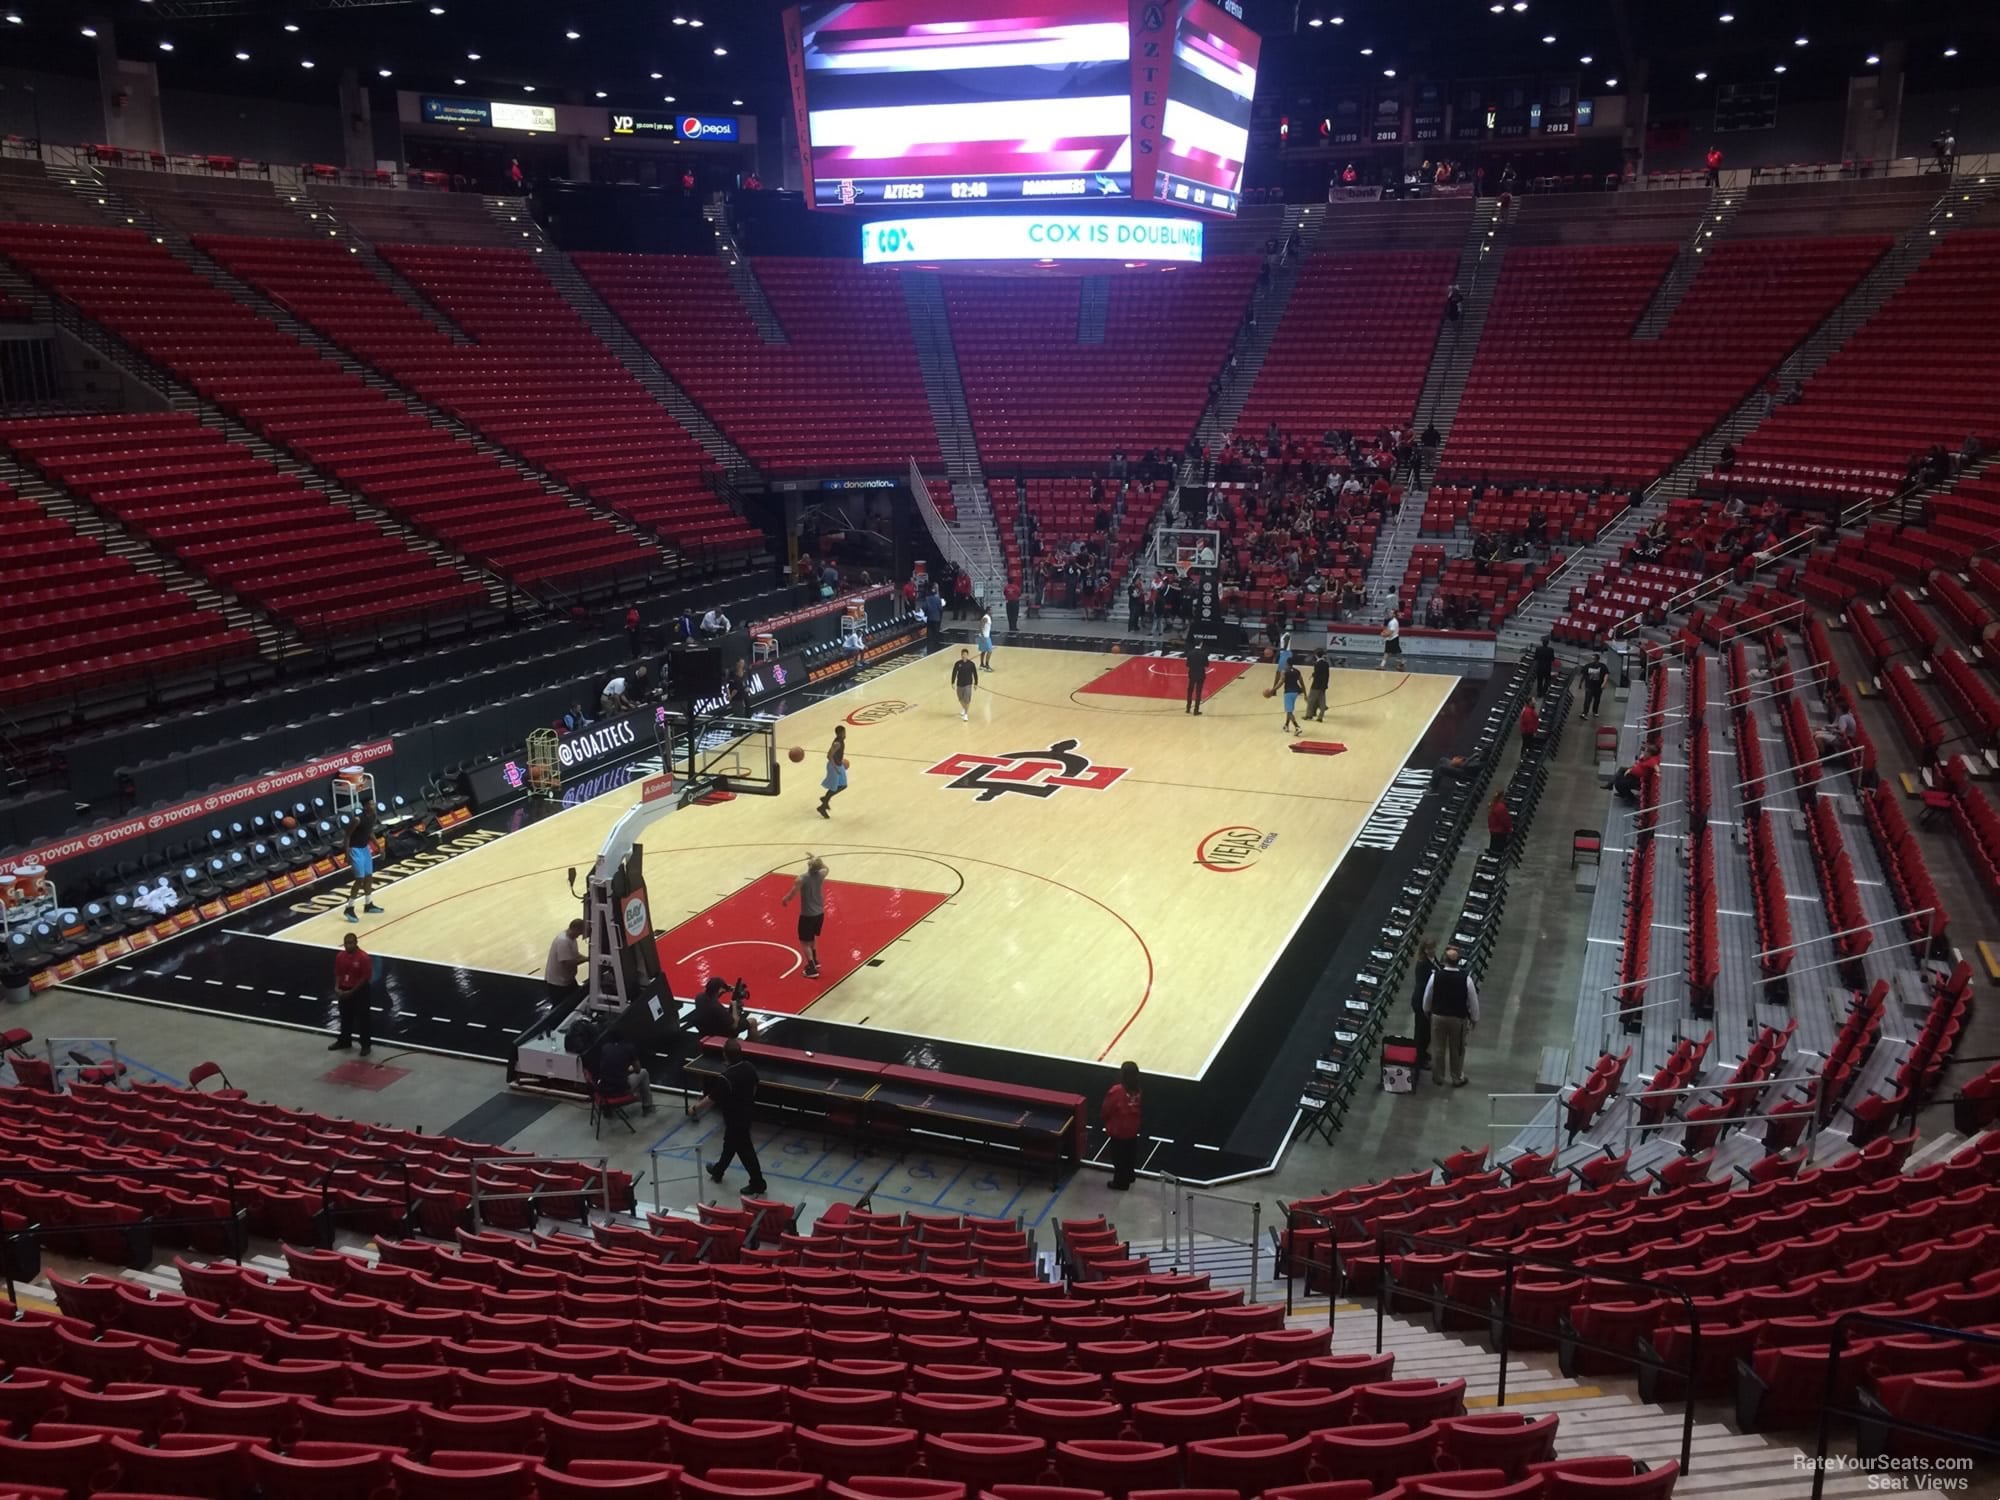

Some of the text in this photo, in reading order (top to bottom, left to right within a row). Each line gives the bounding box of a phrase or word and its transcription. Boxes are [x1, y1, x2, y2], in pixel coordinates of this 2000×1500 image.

[1139, 4, 1166, 154] AZTECS
[613, 115, 634, 130] yp
[702, 124, 732, 134] pepsi
[1547, 124, 1569, 132] 2013
[883, 184, 925, 199] AZTECS
[1028, 224, 1196, 246] COX IS DOUBLING
[364, 743, 393, 759] TOYOTA
[558, 720, 635, 766] @GOAZTECS
[317, 757, 350, 774] TOYOTA
[269, 771, 304, 790] TOYOTA
[218, 786, 255, 805] TOYOTA
[163, 802, 202, 823] TOYOTA
[103, 821, 145, 842] TOYOTA
[1353, 815, 1409, 851] STATE
[39, 841, 84, 863] TOYOTA
[1192, 831, 1262, 864] VIEJAS
